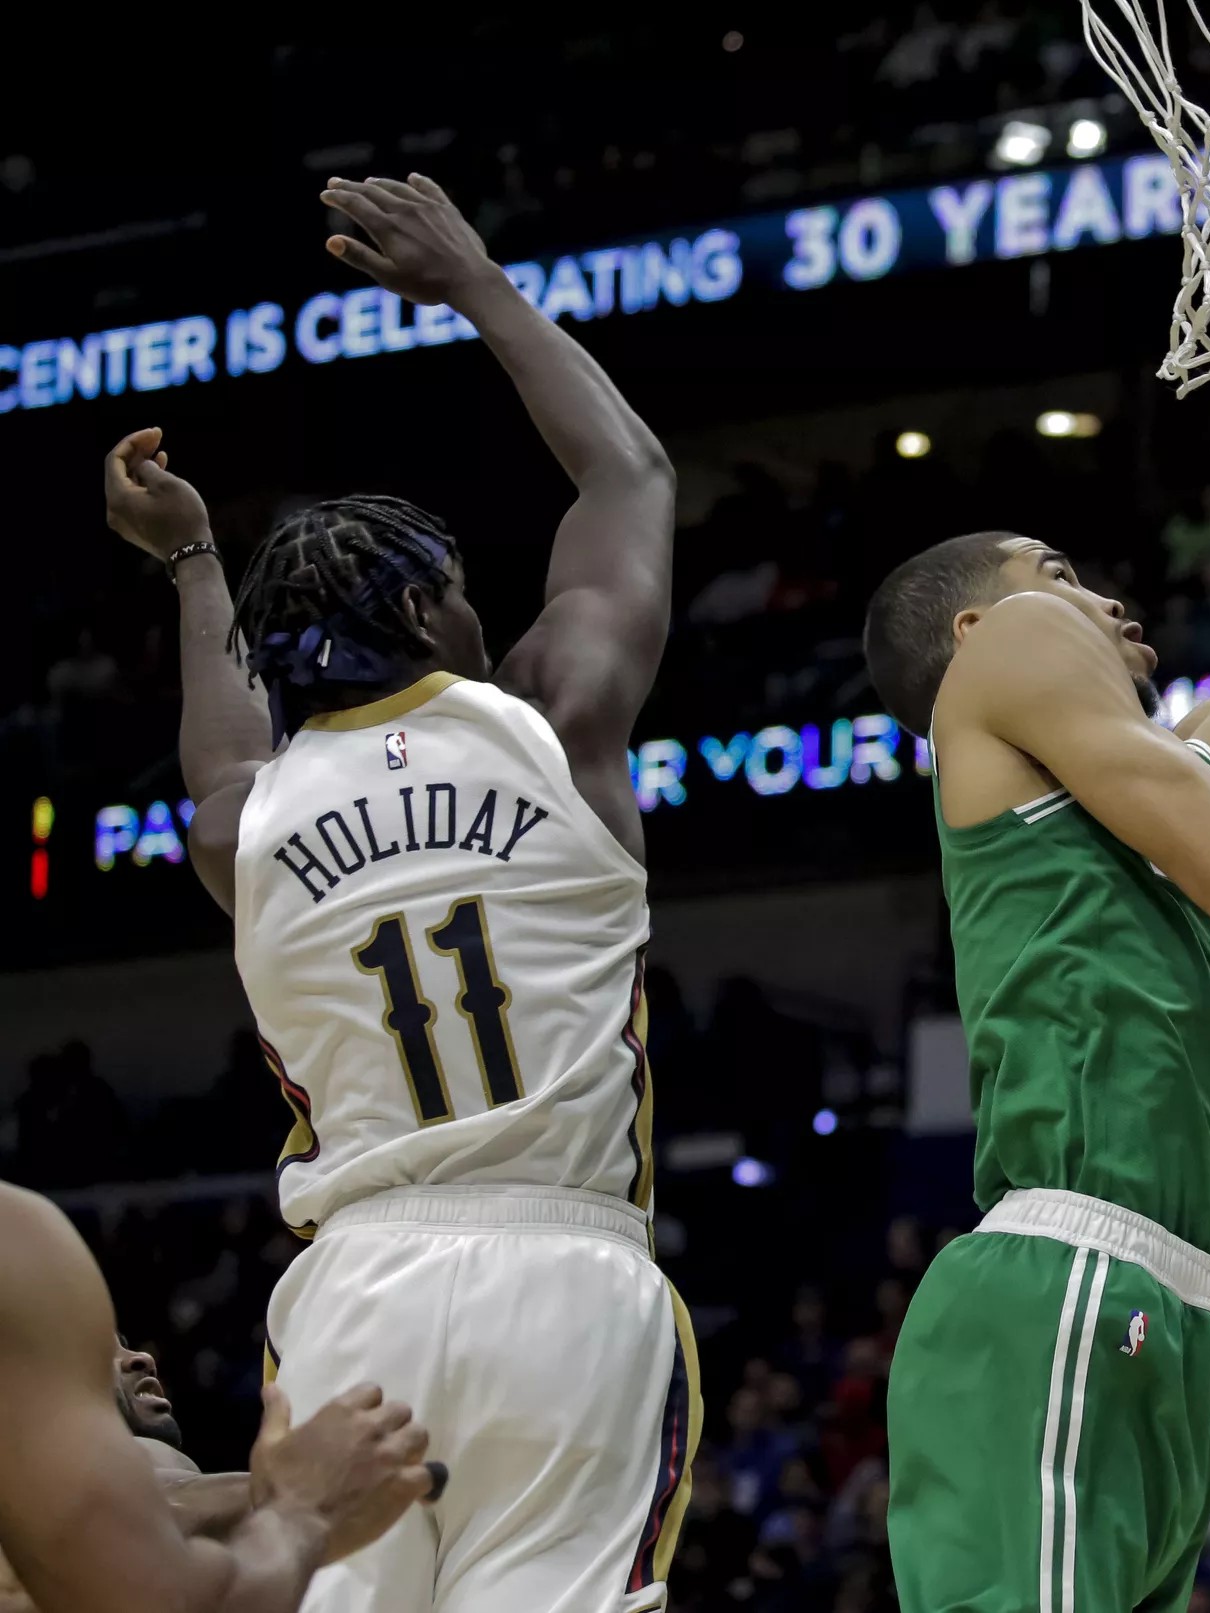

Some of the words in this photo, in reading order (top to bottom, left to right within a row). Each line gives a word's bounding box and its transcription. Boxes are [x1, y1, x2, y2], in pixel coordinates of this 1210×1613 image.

[226, 302, 286, 377] IS
[295, 228, 743, 363] CELEATING
[783, 198, 900, 291] 30
[95, 798, 197, 872] PA
[698, 713, 901, 796] YOUR
[273, 782, 549, 904] HOLIDAY
[350, 894, 526, 1129] 11
